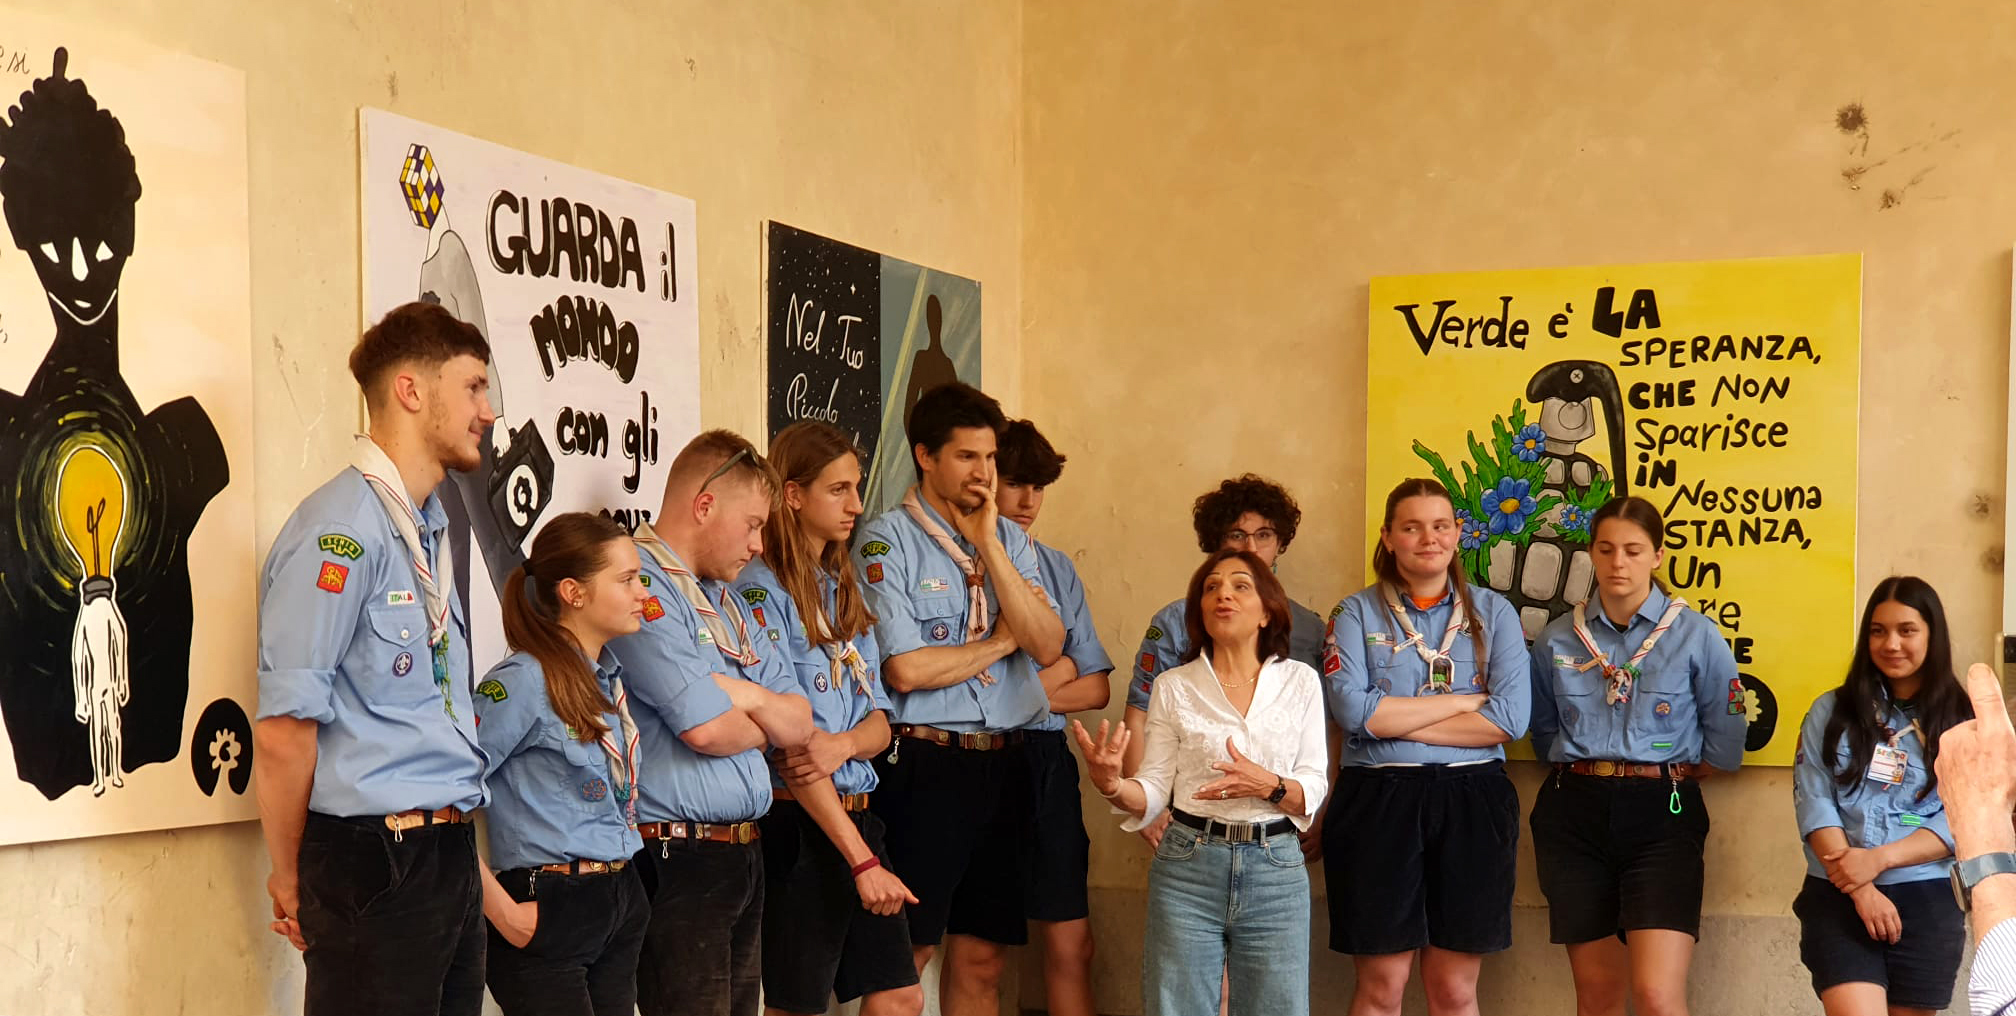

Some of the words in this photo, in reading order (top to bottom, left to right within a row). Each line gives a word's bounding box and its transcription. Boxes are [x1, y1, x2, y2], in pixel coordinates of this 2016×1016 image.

[486, 189, 646, 293] GUARDA
[660, 221, 677, 303] il
[529, 294, 640, 384] MONDO
[786, 292, 826, 355] Nel
[837, 315, 864, 370] Tuo
[1393, 296, 1529, 356] Verde
[1592, 287, 1661, 338] LA
[1619, 334, 1822, 368] SPERANZA,
[786, 372, 839, 423] Piccolo
[1628, 379, 1696, 410] CHE
[554, 406, 609, 459] con
[622, 390, 659, 494] gli
[1634, 413, 1789, 456] Sparisce
[1663, 479, 1823, 518] Nessuna
[1664, 517, 1812, 550] STANZA,
[1668, 555, 1721, 590] Un
